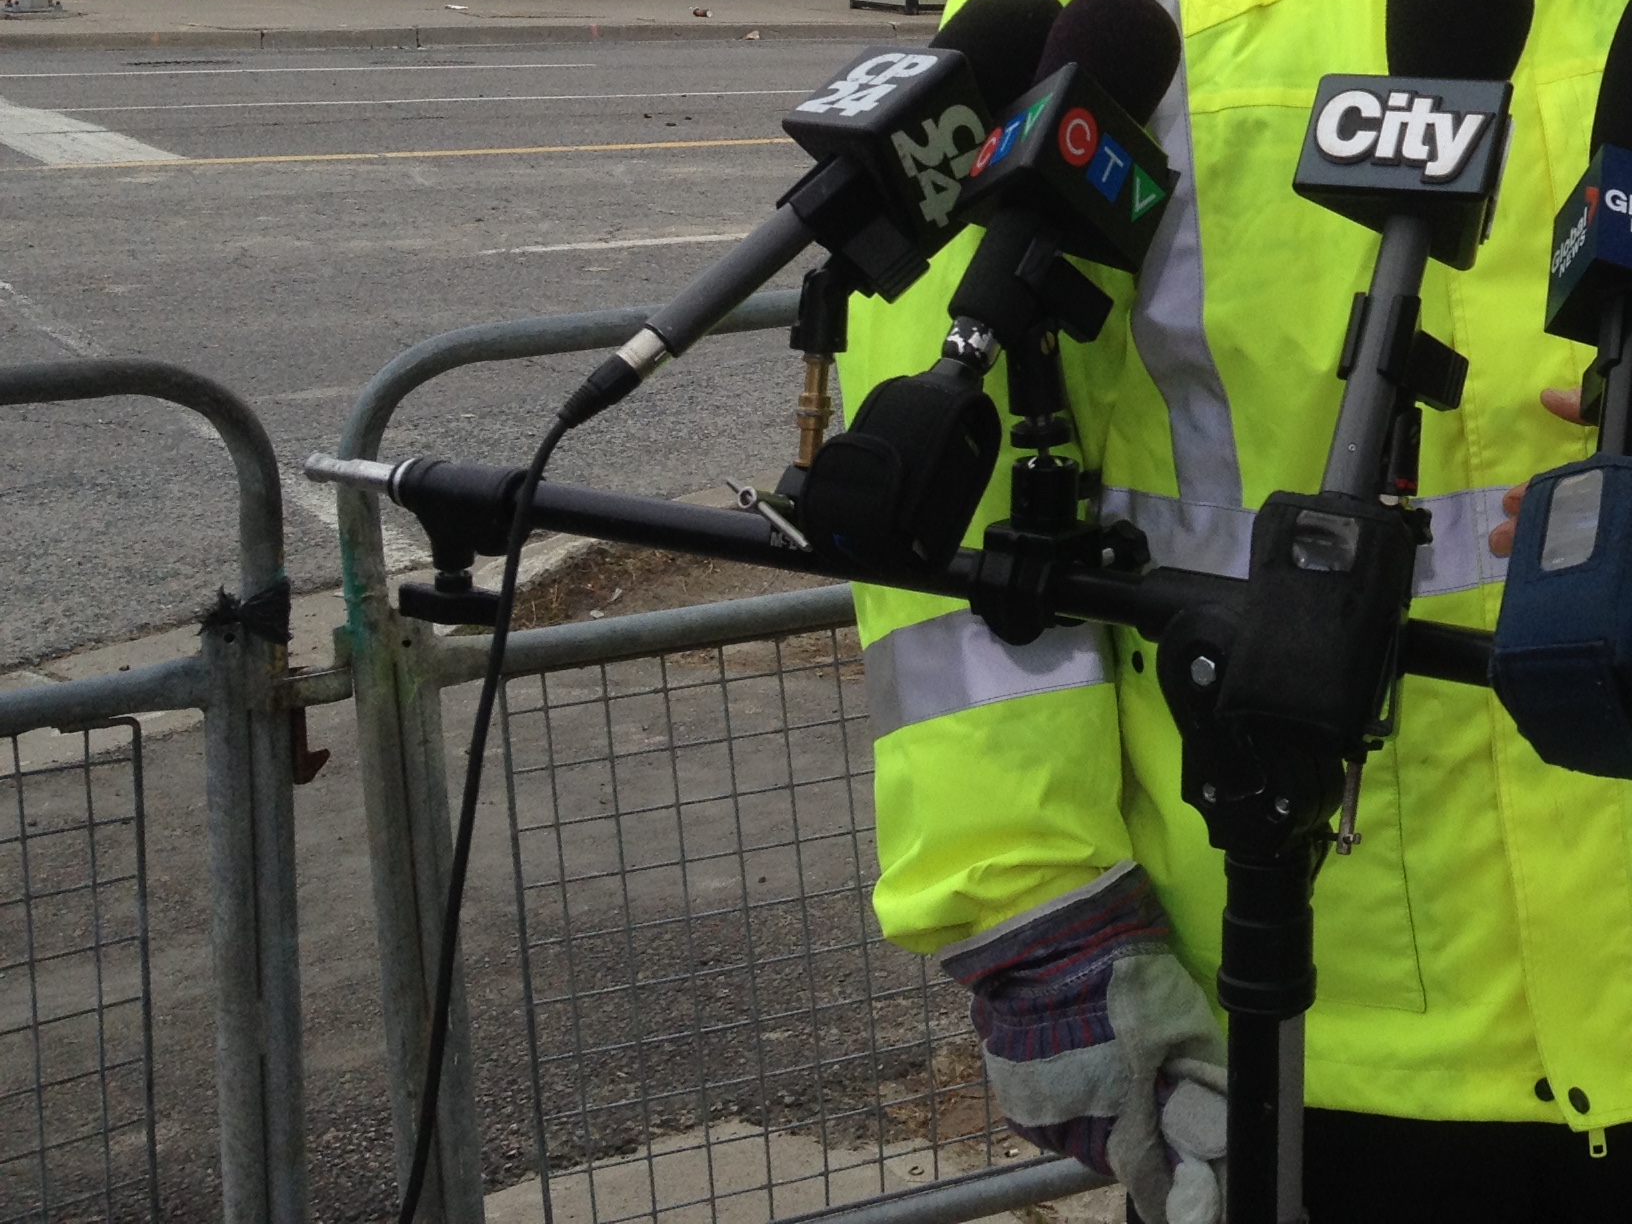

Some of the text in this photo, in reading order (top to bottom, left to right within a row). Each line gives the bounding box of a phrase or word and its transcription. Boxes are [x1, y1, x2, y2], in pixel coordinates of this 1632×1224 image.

[846, 52, 939, 85] CP
[795, 80, 897, 117] 24
[1315, 89, 1487, 177] City
[1064, 116, 1157, 213] CTV
[1551, 206, 1588, 274] Global
[1558, 228, 1588, 278] NEWS
